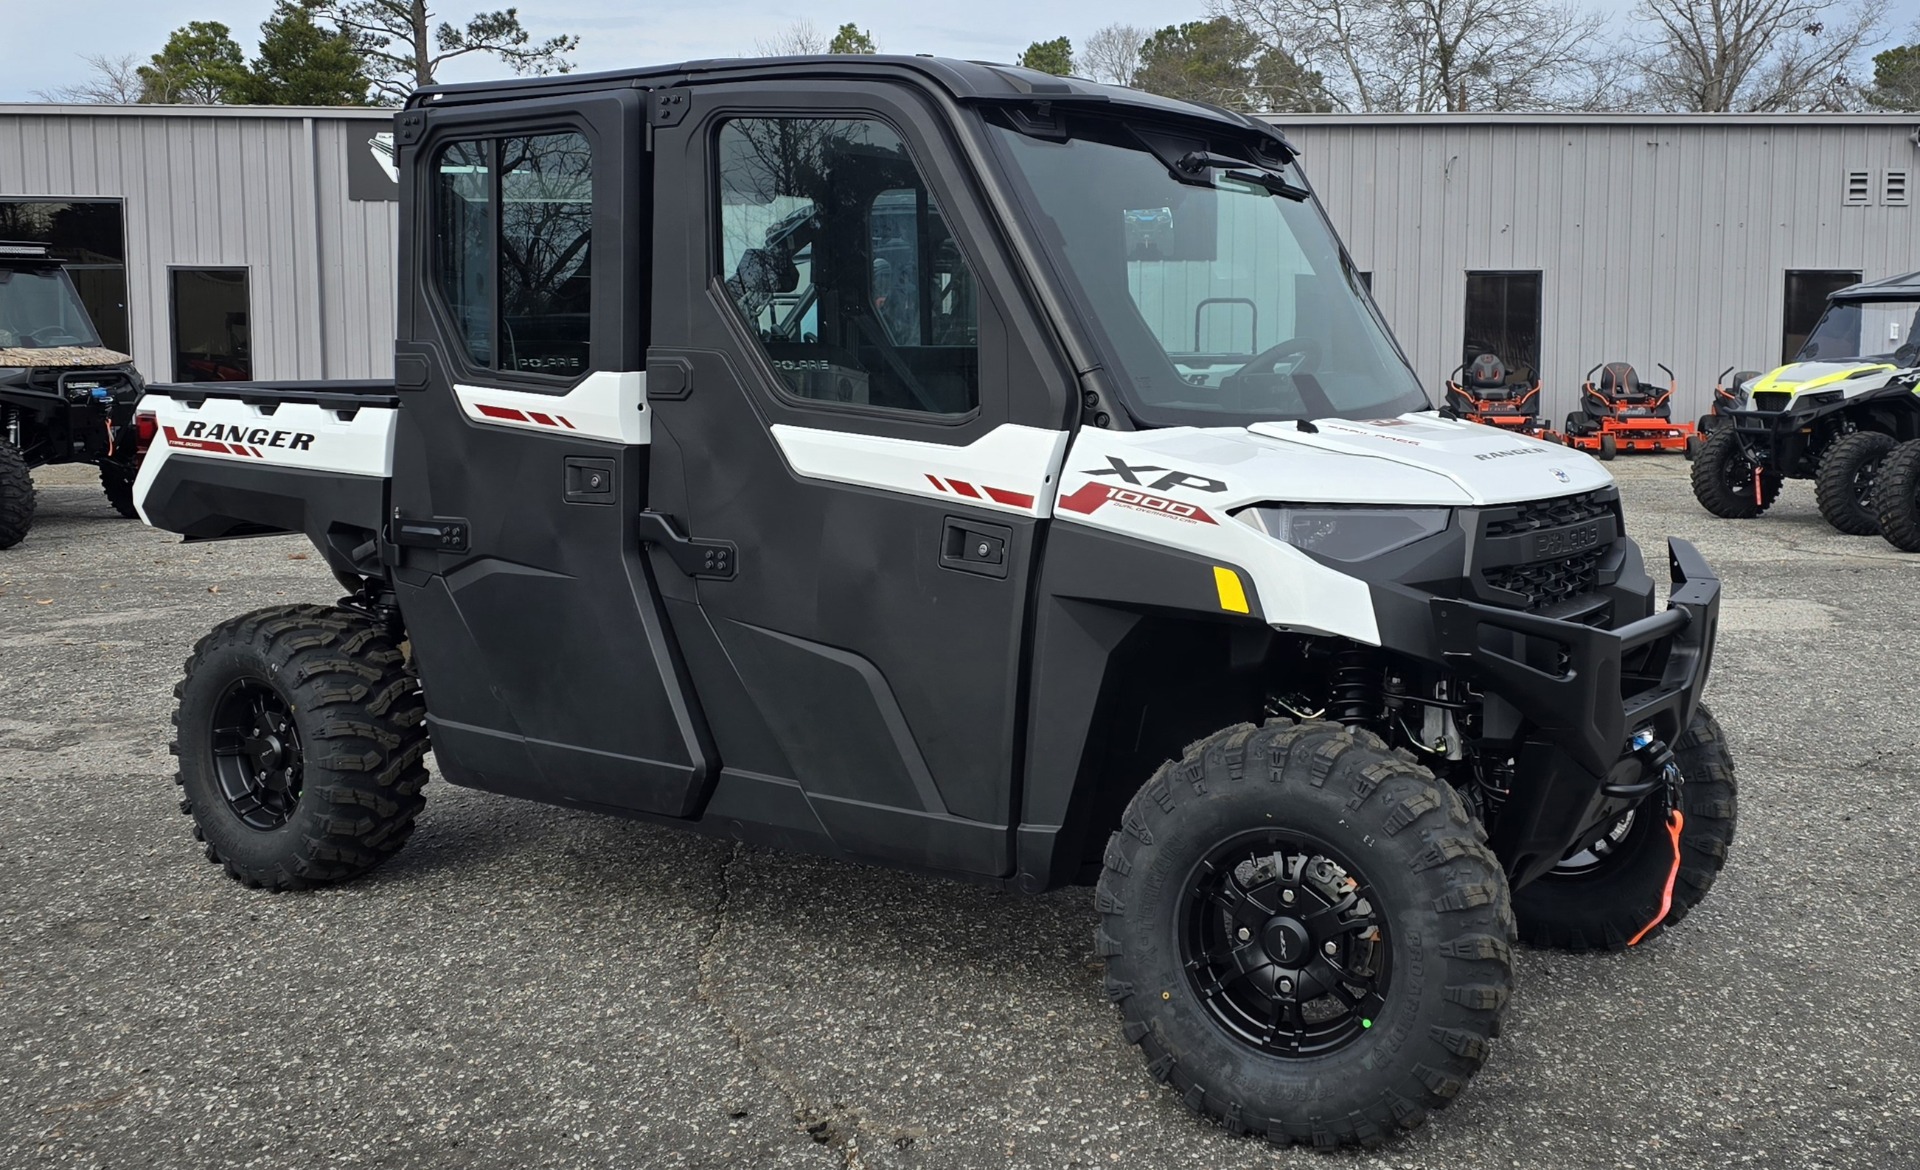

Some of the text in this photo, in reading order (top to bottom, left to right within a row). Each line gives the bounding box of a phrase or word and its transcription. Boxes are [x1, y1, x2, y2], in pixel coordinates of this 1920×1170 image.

[183, 420, 315, 451] RANGER
[1474, 447, 1549, 461] RANGER
[1078, 454, 1229, 494] XP
[1105, 487, 1193, 518] 1000
[1113, 502, 1134, 511] DUAL
[1135, 507, 1179, 521] OVERHEAD
[1537, 526, 1598, 558] POLARIS
